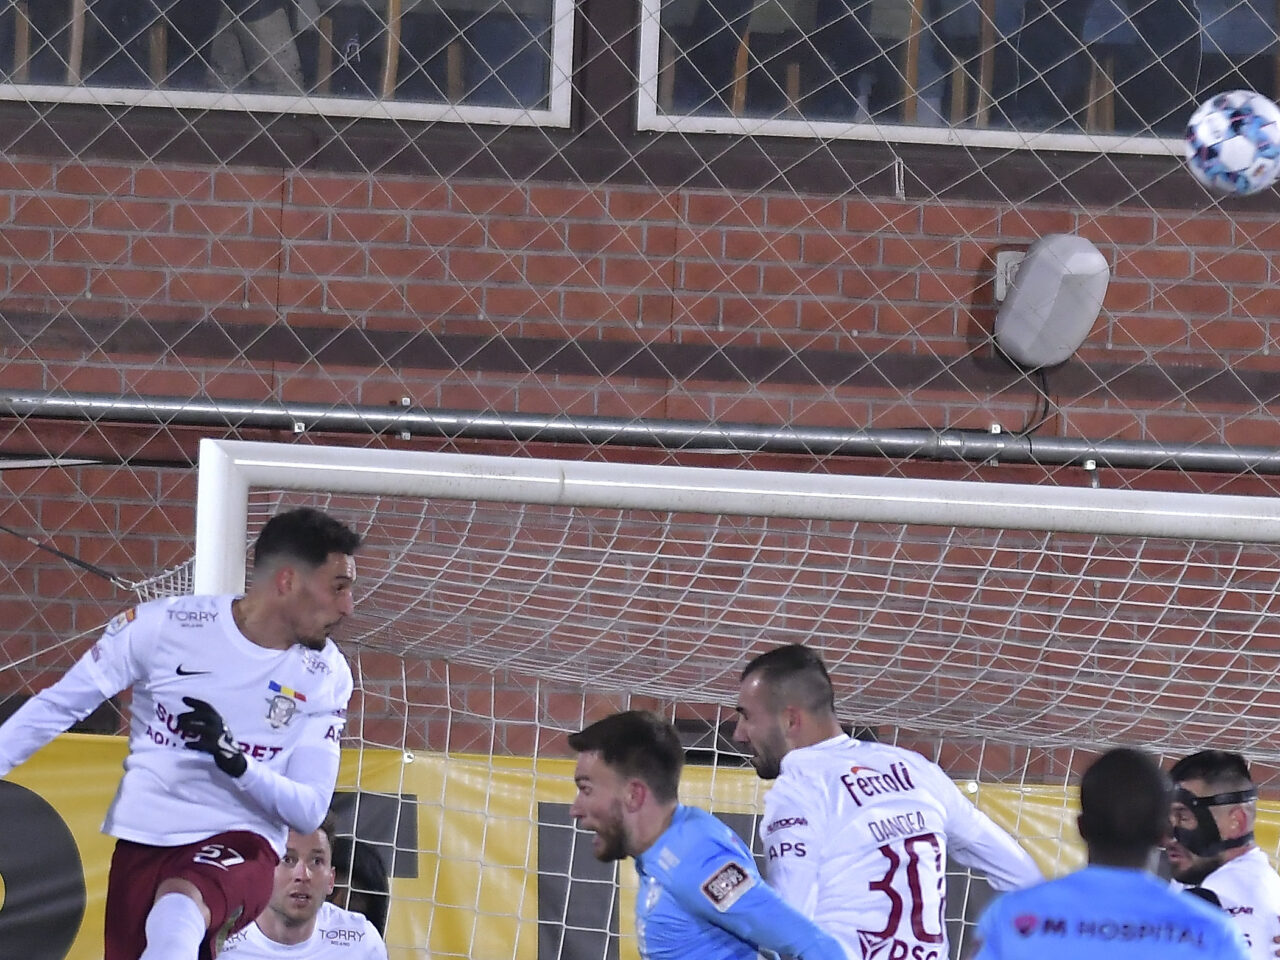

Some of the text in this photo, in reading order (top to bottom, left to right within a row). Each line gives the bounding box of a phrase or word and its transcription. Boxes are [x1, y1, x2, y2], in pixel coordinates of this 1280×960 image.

[841, 762, 915, 807] Ferroli
[769, 842, 807, 861] APS
[319, 929, 365, 942] TORRY
